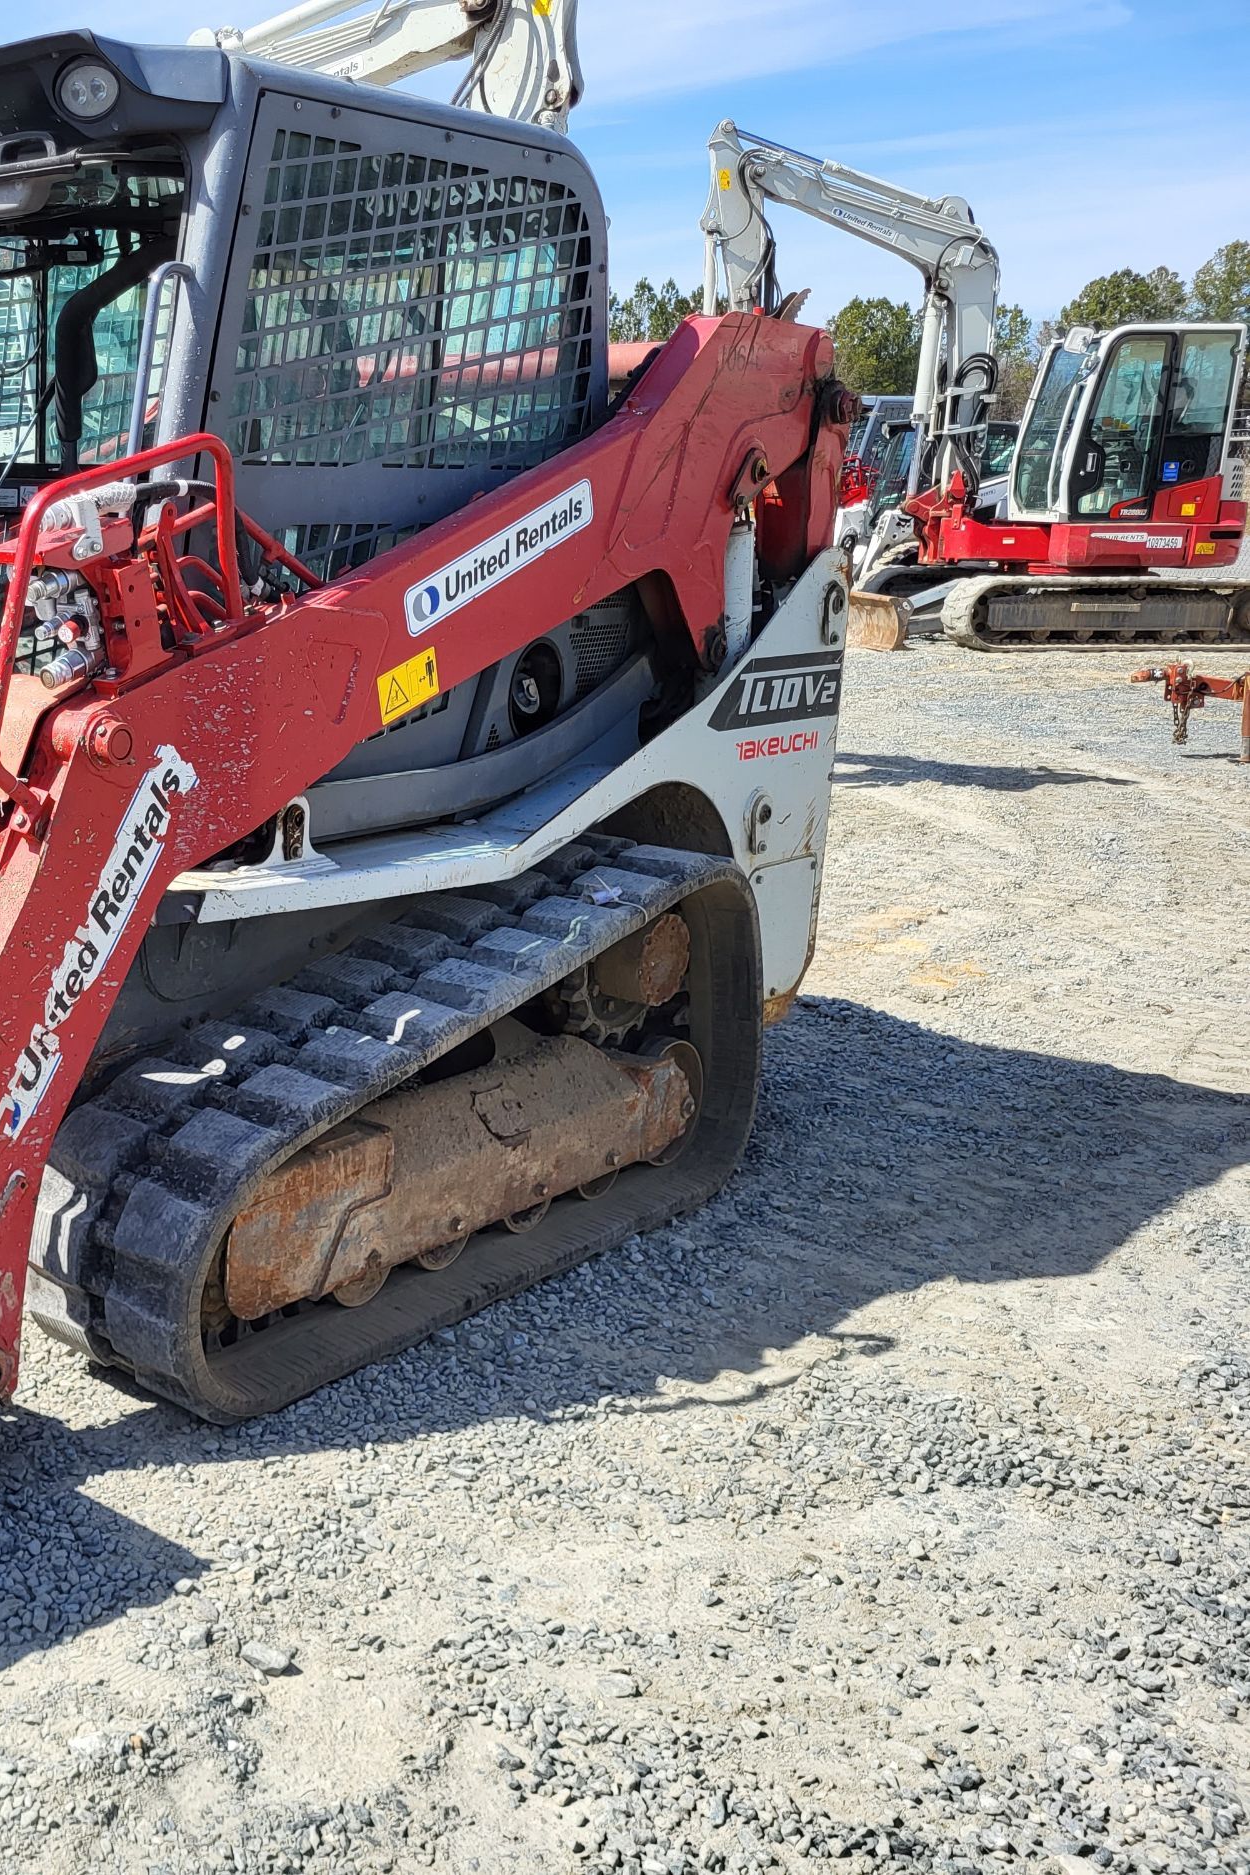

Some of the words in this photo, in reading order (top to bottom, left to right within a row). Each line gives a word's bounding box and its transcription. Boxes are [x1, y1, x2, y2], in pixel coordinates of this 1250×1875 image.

[842, 211, 867, 227] United
[866, 219, 893, 237] Rentals
[445, 537, 510, 602] United
[515, 497, 583, 558] Rentals
[738, 664, 841, 715] TL10V2
[735, 730, 820, 761] TAKEUCHI
[91, 768, 181, 936] Rentals
